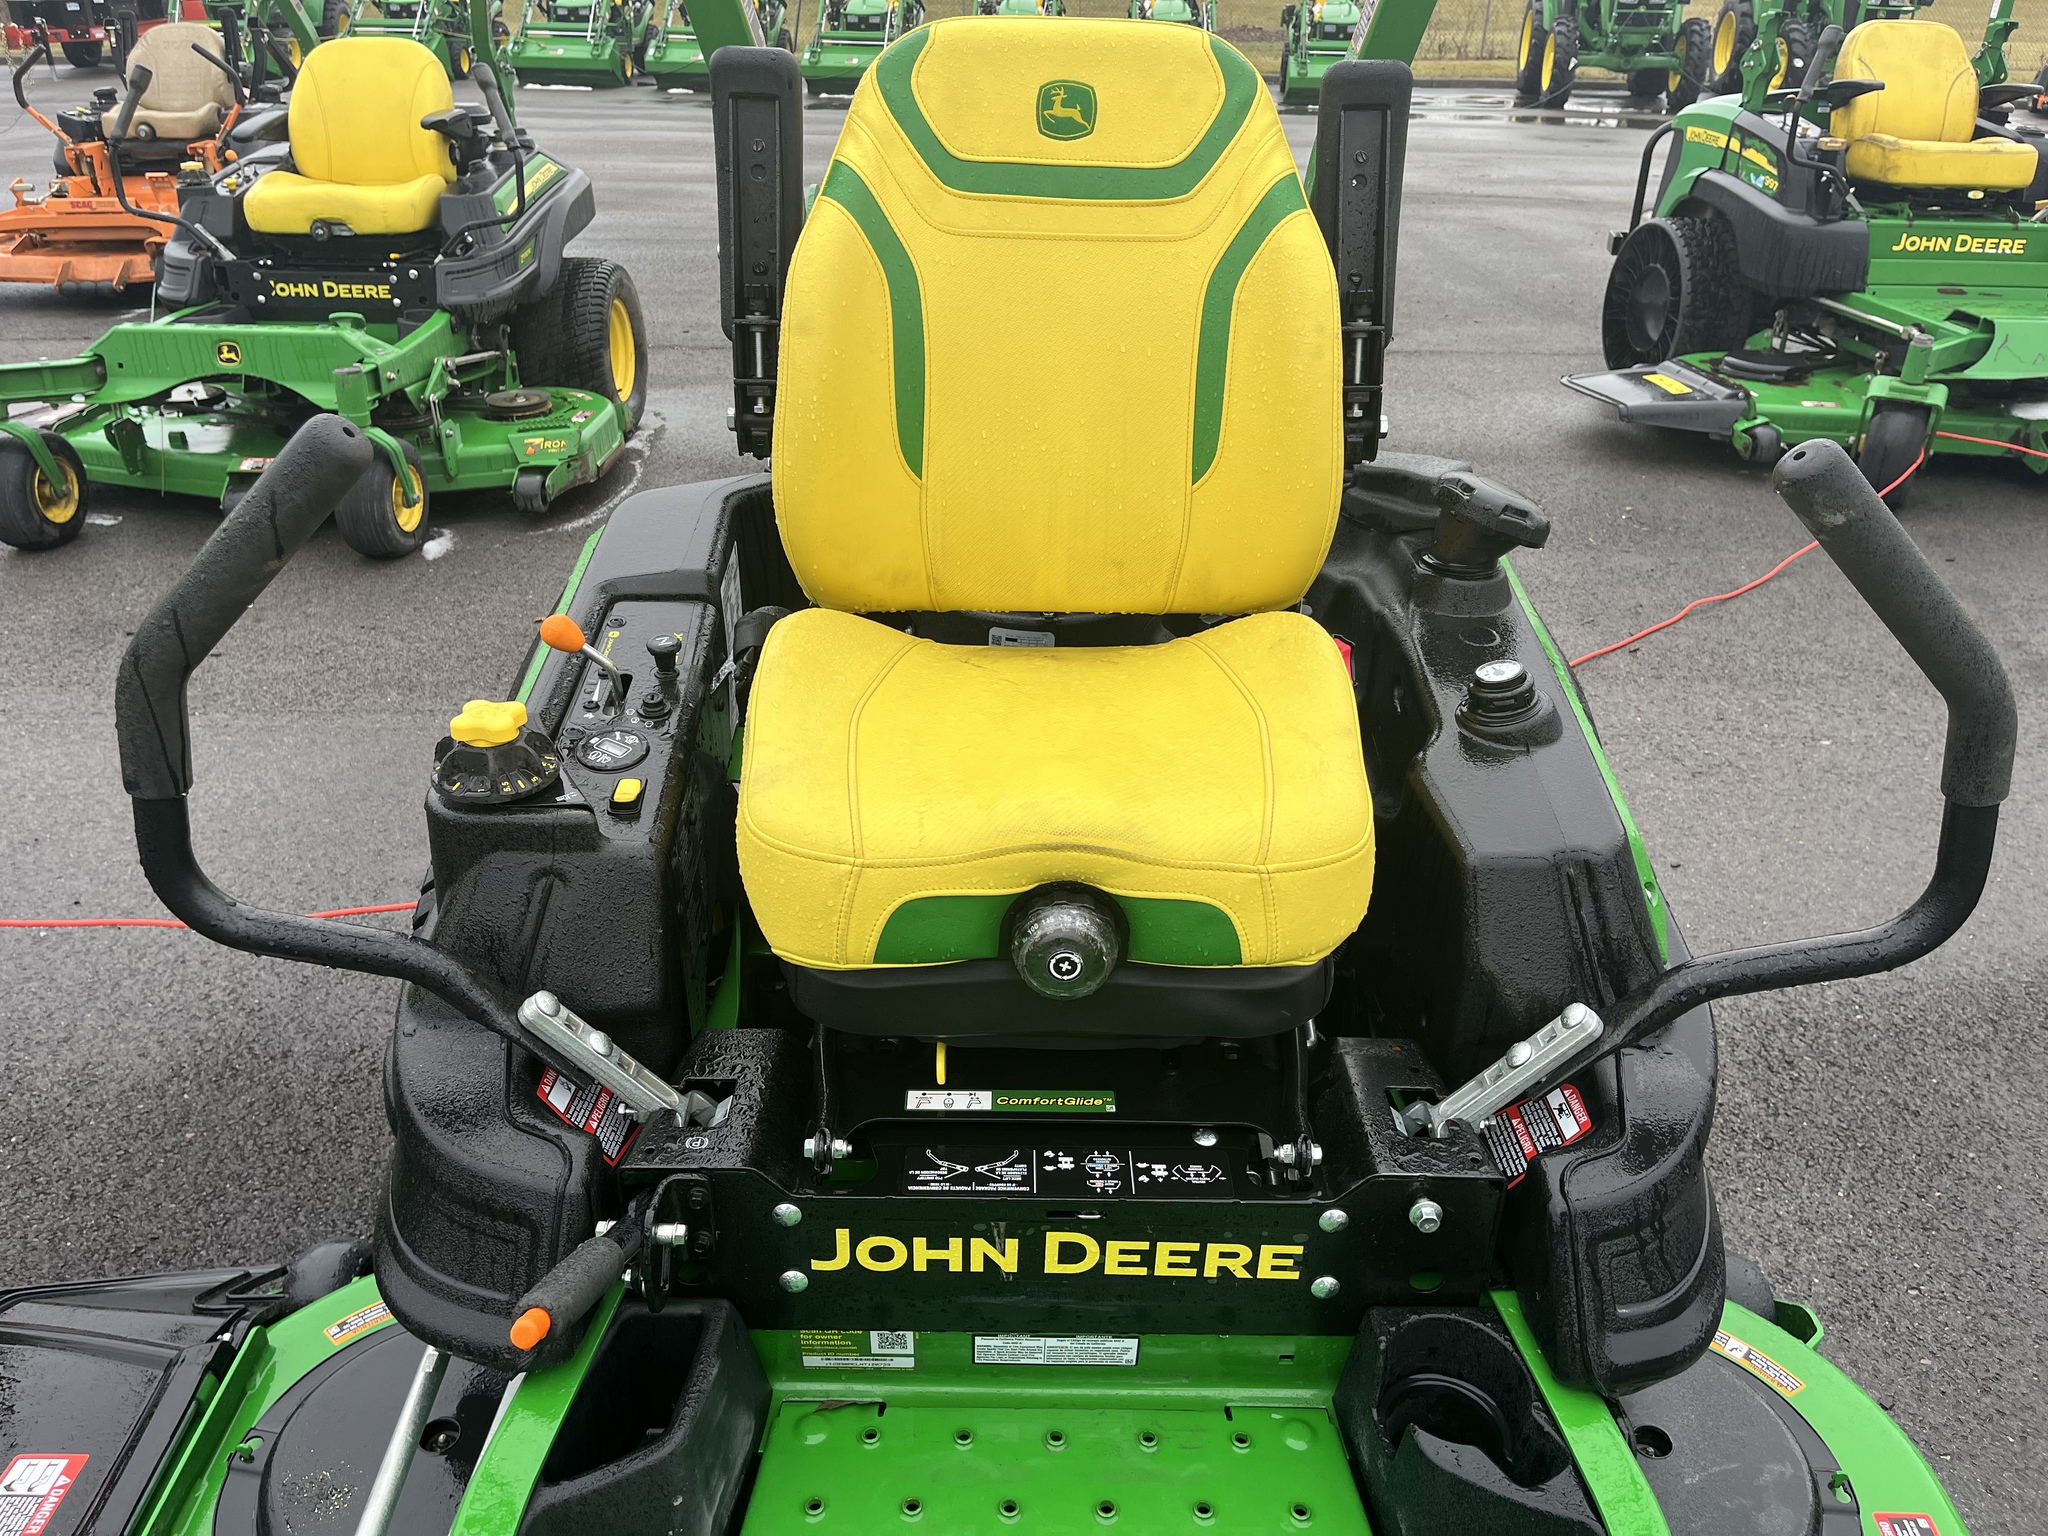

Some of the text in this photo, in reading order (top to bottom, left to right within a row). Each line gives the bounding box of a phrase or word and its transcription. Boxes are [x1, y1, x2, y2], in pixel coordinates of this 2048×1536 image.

[70, 201, 93, 210] SCAG
[1892, 232, 2027, 255] JOHN DEERE
[322, 281, 392, 299] DEERE
[501, 781, 512, 792] 5.5
[592, 1092, 610, 1123] PELIGRO
[1567, 1095, 1588, 1124] DANGER
[1514, 1123, 1534, 1154] PELIGRO
[810, 1228, 1304, 1280] JOHN DEERE
[1748, 1363, 1777, 1384] WARNING
[25, 1488, 65, 1534] DANGER
